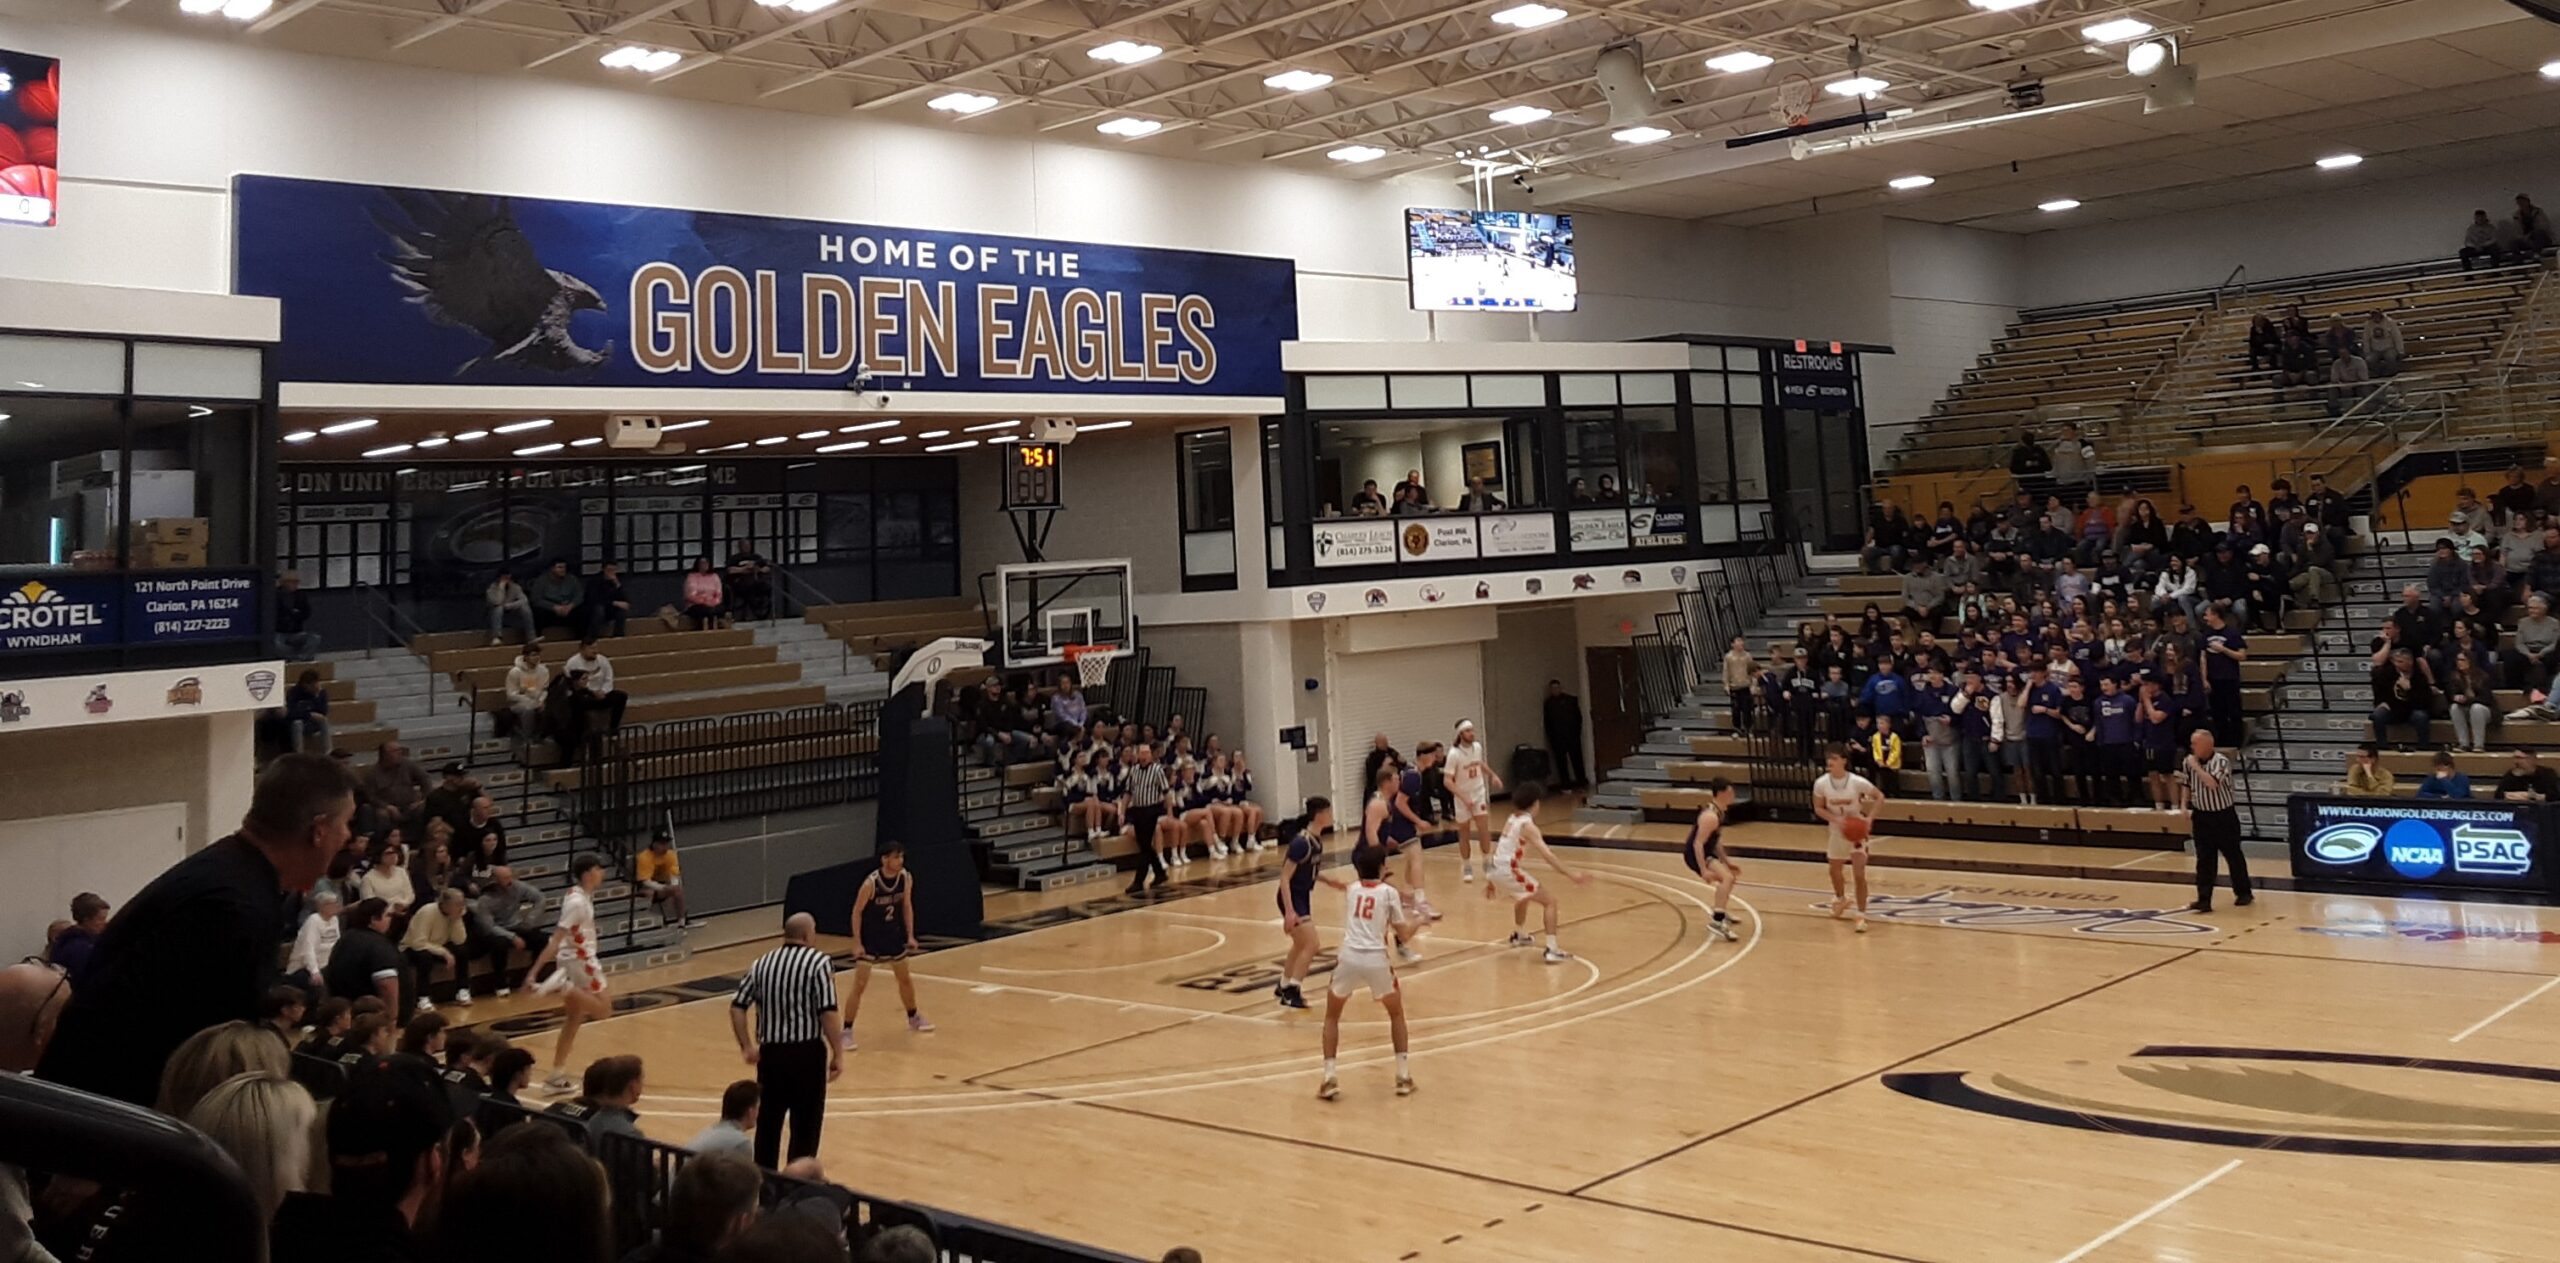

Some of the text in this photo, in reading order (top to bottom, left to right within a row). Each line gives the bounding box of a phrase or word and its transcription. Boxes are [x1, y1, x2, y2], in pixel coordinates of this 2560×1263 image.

[819, 234, 1079, 278] HOME OF THE
[630, 260, 1216, 384] GOLDEN EAGLES
[1783, 354, 1844, 371] RESTROOMS
[1021, 447, 1053, 467] 7:51
[1462, 537, 1472, 545] PA
[1635, 535, 1684, 546] ATHLETICS
[135, 578, 250, 593] 121 North Point Drive
[146, 598, 238, 613] Clarion, PA 16214
[154, 618, 230, 635] (814) 227-2223
[7, 633, 82, 648] WYNDHAM
[2317, 805, 2514, 821] WWW.CLARIONGOLDENEAGLES.COM
[2391, 846, 2444, 865] NCAA
[2457, 840, 2527, 861] PSAC
[885, 905, 895, 921] 2
[1355, 895, 1375, 920] 12
